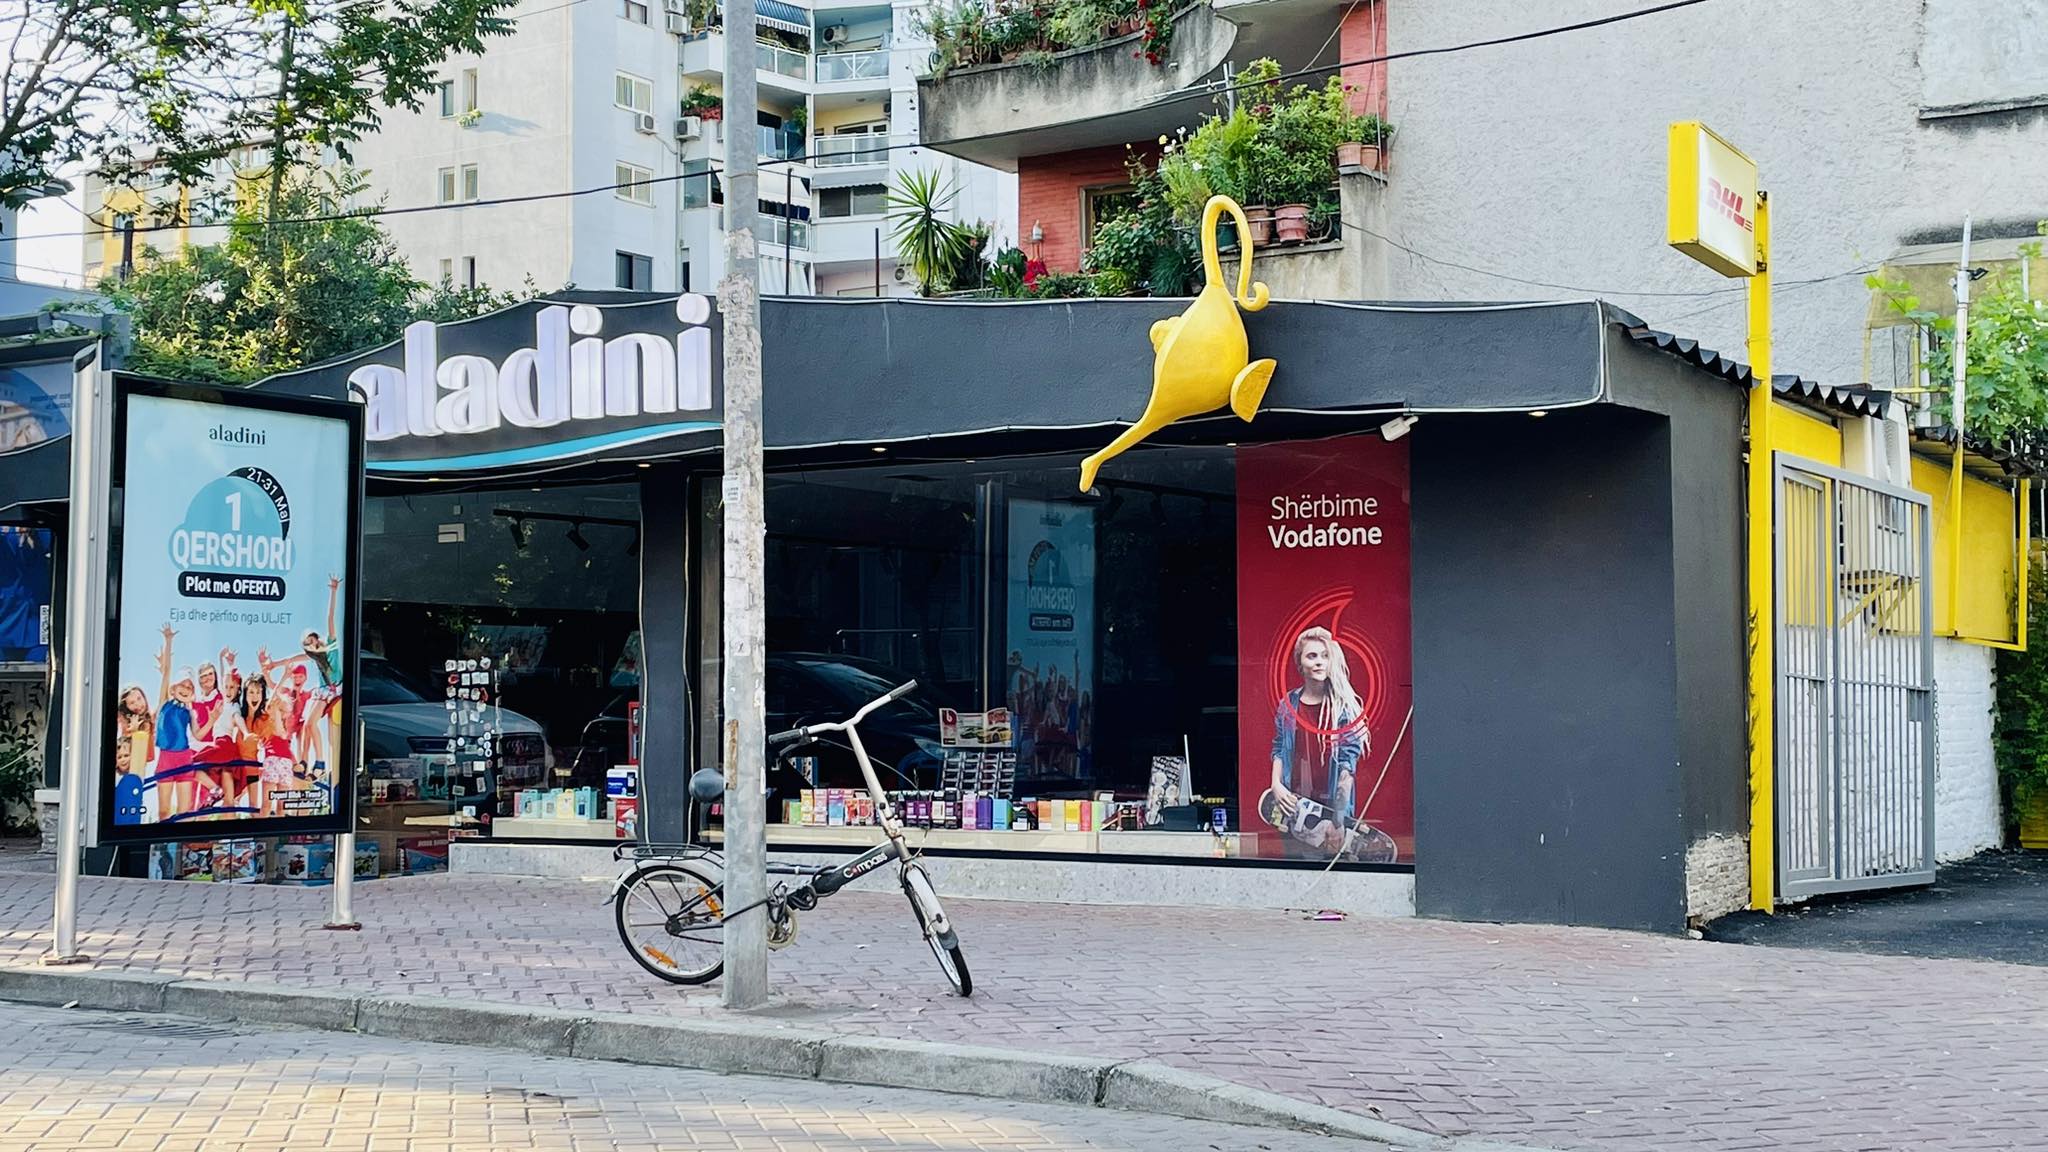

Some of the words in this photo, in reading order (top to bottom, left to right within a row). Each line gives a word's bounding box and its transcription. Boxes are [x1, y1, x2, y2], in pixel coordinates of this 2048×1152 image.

[1705, 176, 1746, 228] DHL
[347, 292, 712, 442] aladini
[208, 424, 266, 446] aladini
[246, 467, 278, 496] 21-31
[225, 491, 241, 532] 1
[1271, 493, 1379, 520] Shërbime
[1267, 522, 1383, 549] Vodafone
[172, 529, 292, 571] QERSHORI
[185, 575, 212, 593] Plot
[213, 580, 230, 594] me
[232, 579, 281, 597] OFERTA
[169, 607, 186, 622] Eja
[188, 608, 208, 621] dhe
[241, 612, 259, 626] nga
[261, 612, 293, 625] ULJET
